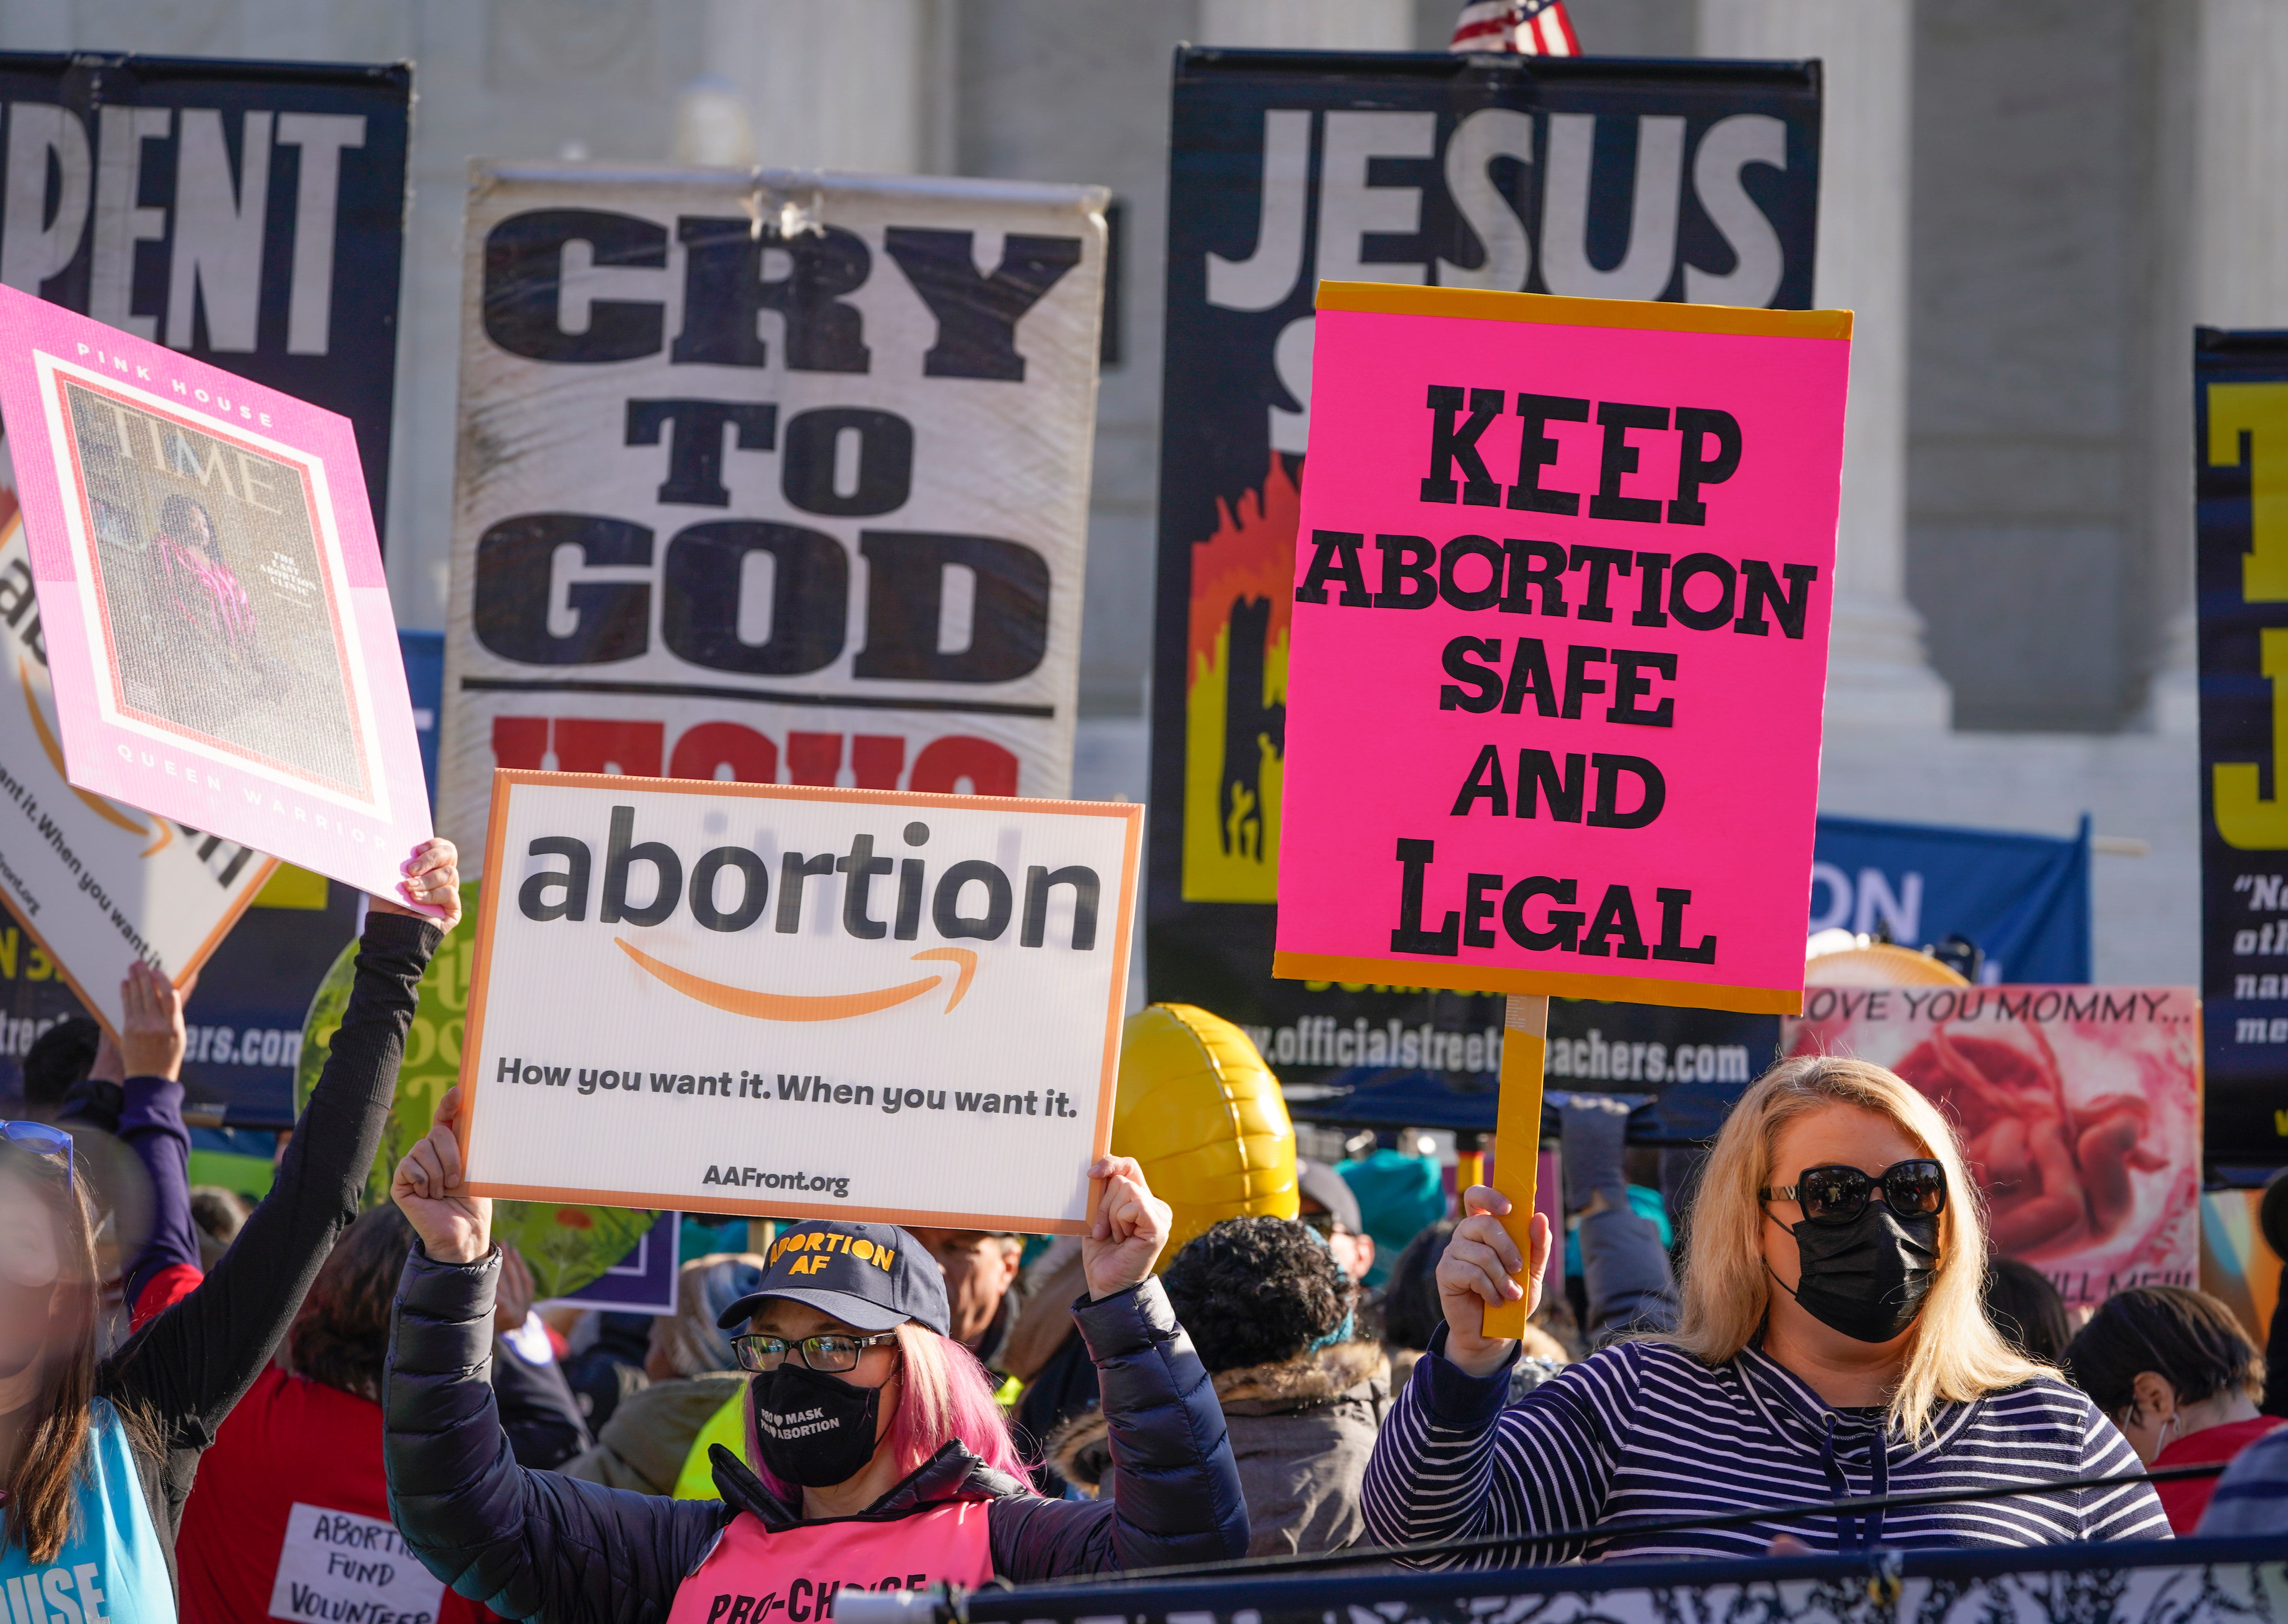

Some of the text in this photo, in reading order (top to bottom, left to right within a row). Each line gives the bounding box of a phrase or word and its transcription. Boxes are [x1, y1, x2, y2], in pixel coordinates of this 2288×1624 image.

[1204, 108, 1787, 312] JESUS
[481, 208, 1082, 382] CRY
[77, 342, 273, 428] PINK HOUSE
[94, 397, 282, 516] TIME
[626, 398, 915, 518] TO
[1420, 384, 1742, 526] KEEP
[473, 512, 1051, 683] GOD
[1296, 529, 1817, 639] ABORTION
[1439, 635, 1678, 728] SAFE
[117, 744, 387, 851] QUEEN WARRIOR
[1450, 744, 1666, 828] AND
[38, 812, 82, 875] When
[77, 871, 112, 912] you
[518, 806, 1100, 951] abortion
[1788, 988, 2190, 1024] OVE YOU MOMMY...
[496, 1057, 1077, 1118] How you want it. When you want it.
[703, 1165, 850, 1199] AAFront.org
[770, 1232, 895, 1272] ABORTION
[788, 1255, 830, 1275] AF
[777, 1417, 840, 1440] ABORTION
[785, 1407, 824, 1425] MASK
[327, 1552, 396, 1588] FUND
